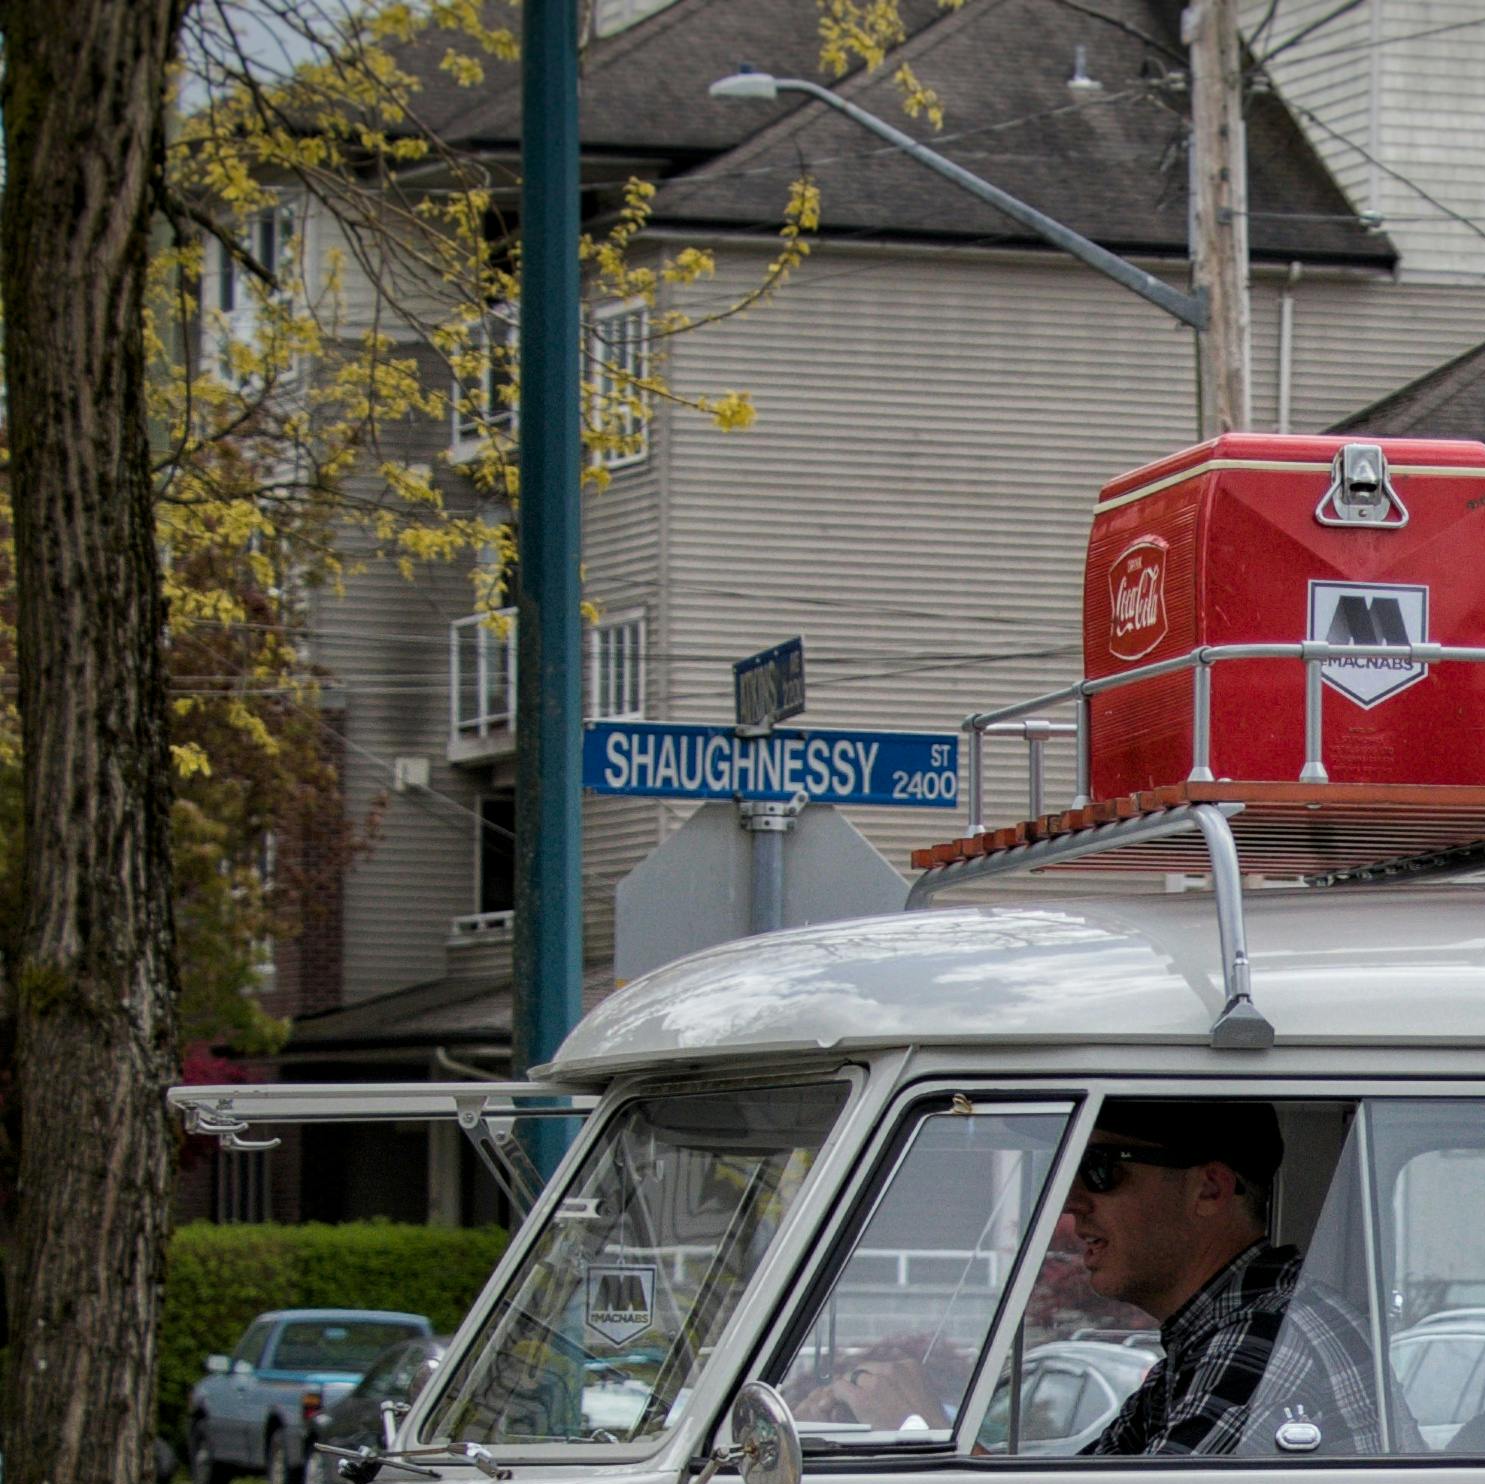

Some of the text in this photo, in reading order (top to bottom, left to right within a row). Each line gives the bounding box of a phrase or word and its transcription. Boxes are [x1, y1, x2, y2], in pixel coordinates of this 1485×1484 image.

[604, 731, 952, 796] SHAUGHNESSY ST
[892, 769, 957, 800] 2400
